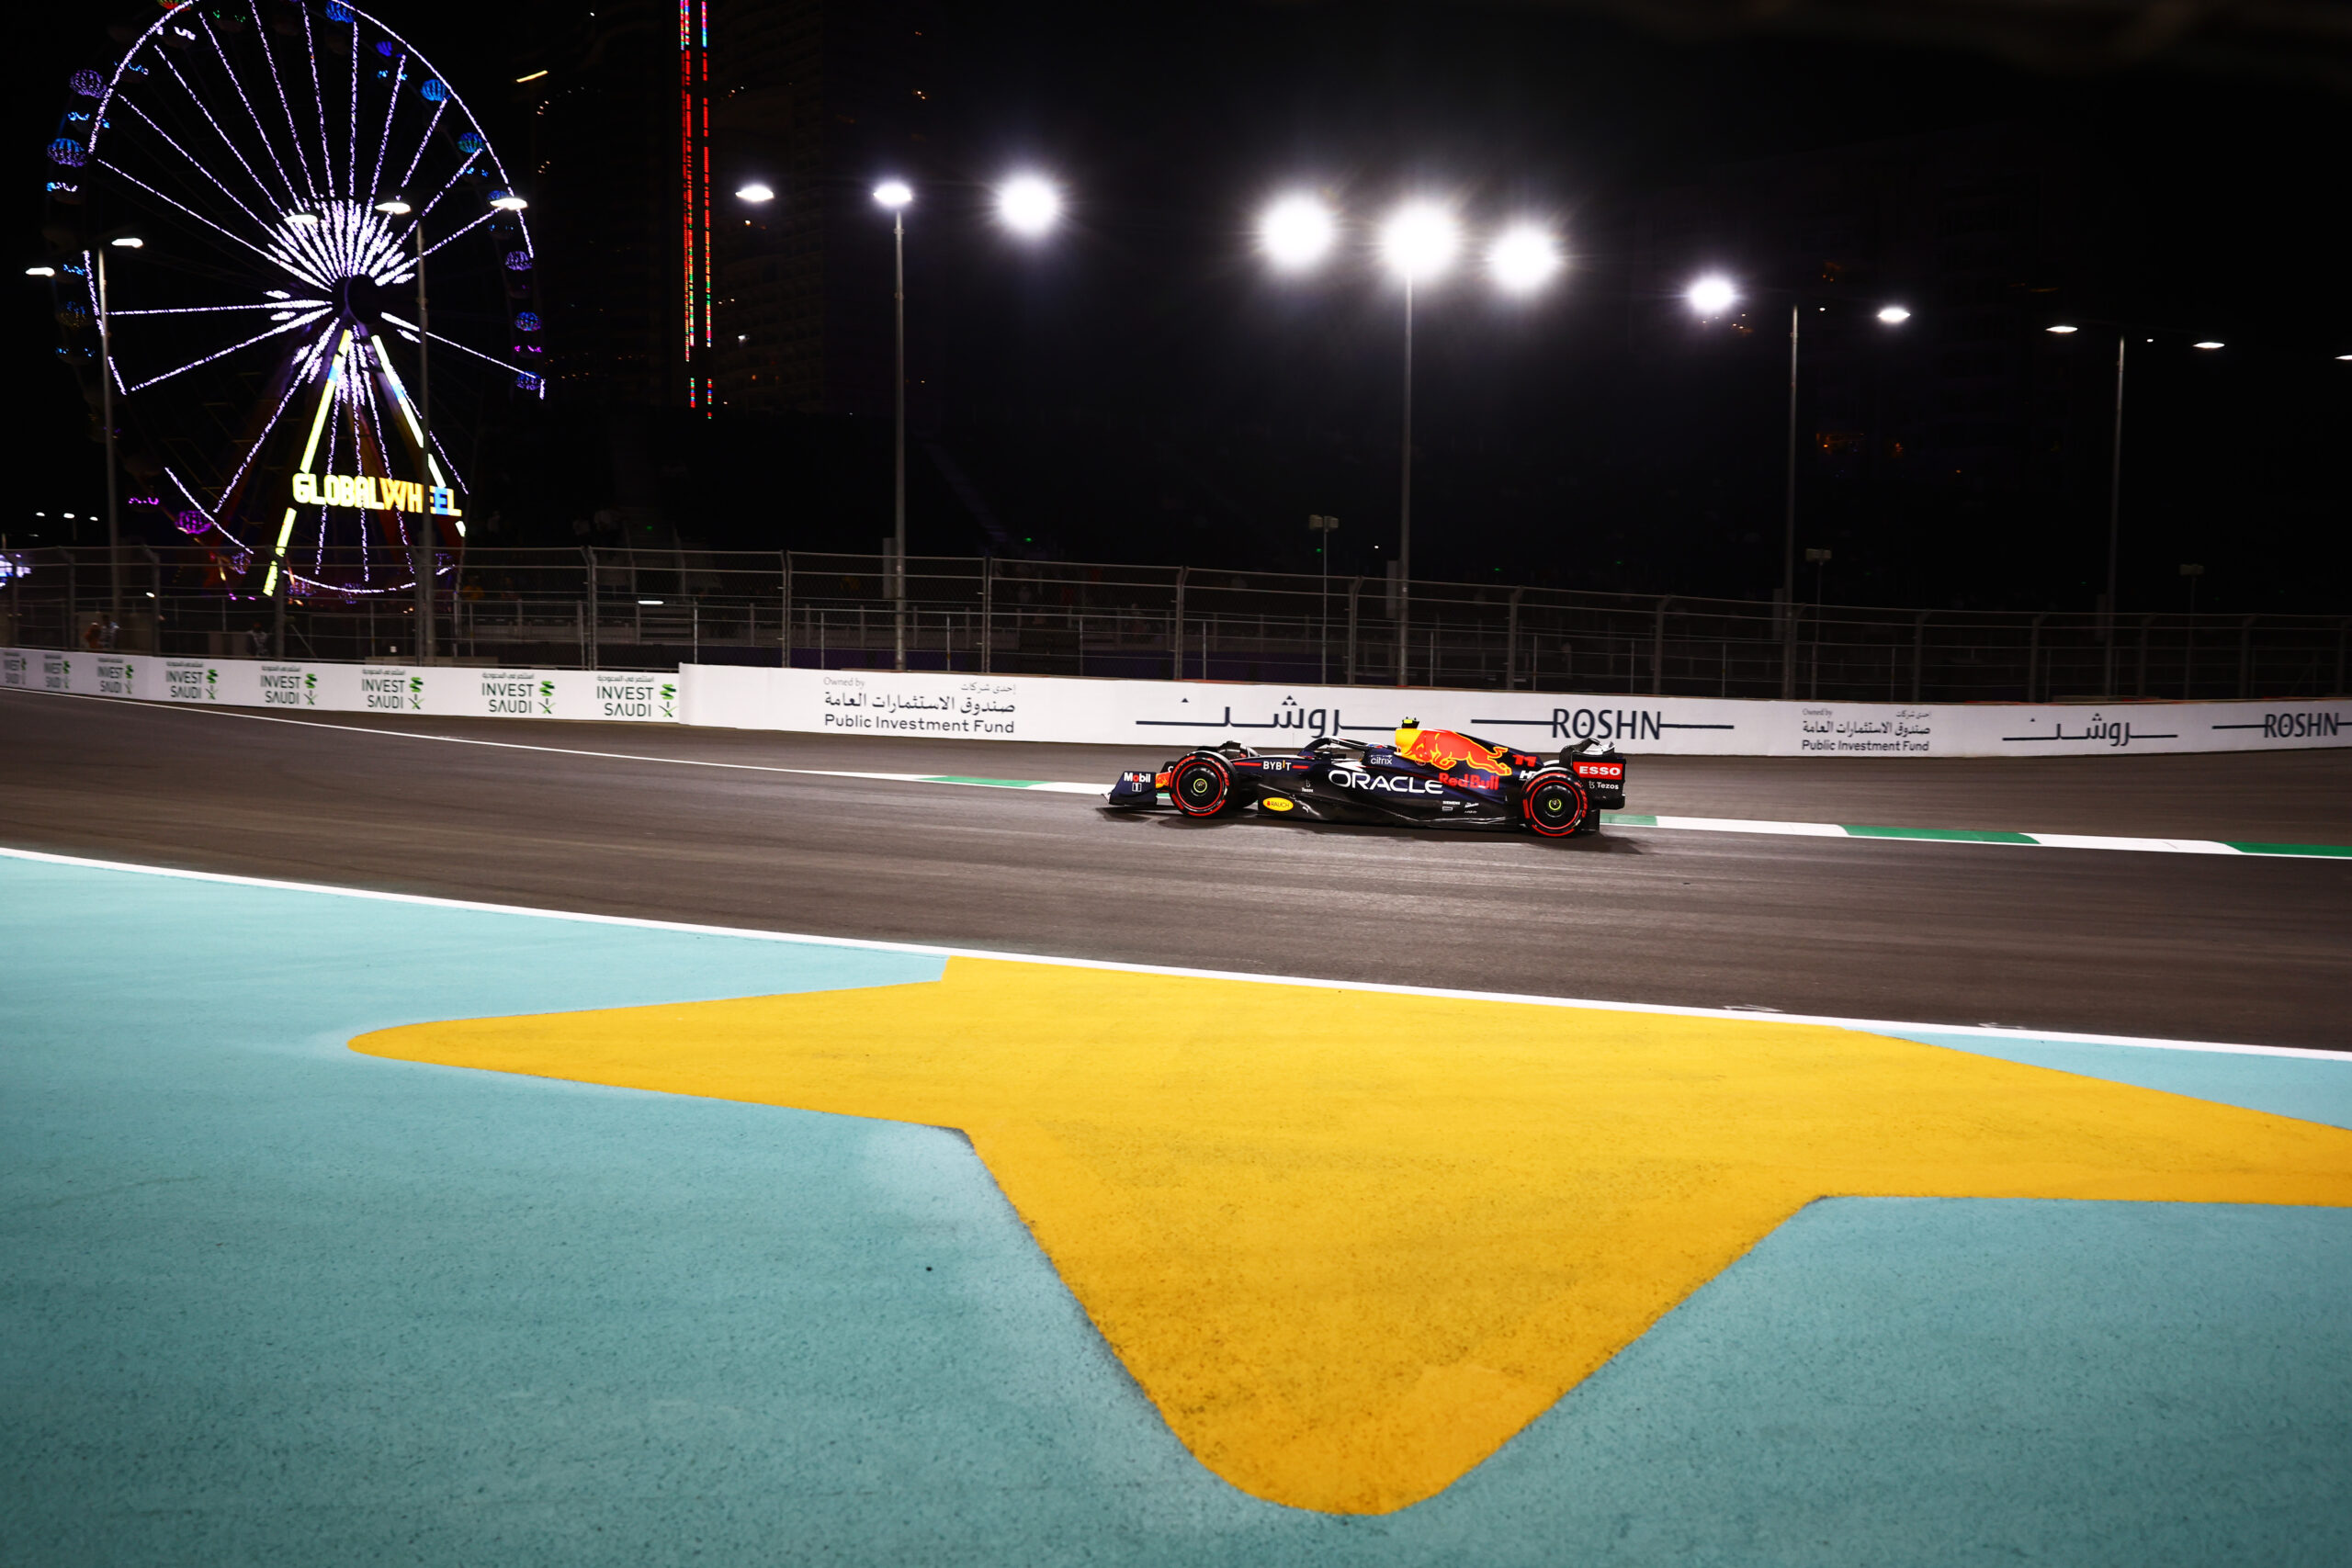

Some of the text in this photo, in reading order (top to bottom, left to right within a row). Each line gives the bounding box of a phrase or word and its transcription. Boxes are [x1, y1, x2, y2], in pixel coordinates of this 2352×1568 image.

[165, 671, 203, 683] INVEST
[260, 675, 301, 689] INVEST
[823, 676, 865, 690] Owned by
[170, 685, 201, 699] SAUDI
[361, 679, 405, 693] INVEST
[481, 682, 534, 697] INVEST
[596, 686, 654, 700] INVEST
[265, 691, 300, 705] SAUDI
[368, 694, 403, 709] SAUDI
[825, 692, 1015, 716] صندوق الاستثمارات العامة
[489, 699, 532, 713] SAUDI
[605, 702, 651, 716] SAUDI
[824, 713, 1014, 733] Public Investment Fund
[1552, 708, 1661, 740] ROSHN
[1803, 720, 1834, 733] العامة
[1895, 722, 1930, 738] صندوق
[2264, 712, 2339, 738] ROSHN
[1802, 739, 1929, 751] Public Investment Fund
[1262, 760, 1292, 771] BYBIT
[1370, 756, 1392, 764] citrix
[1512, 754, 1537, 767] 11
[1579, 765, 1621, 775] ESSO
[1124, 772, 1150, 783] Mobil
[1329, 770, 1443, 795] ORACLE
[1438, 773, 1499, 790] Red Bull
[1596, 782, 1619, 790] Tezos
